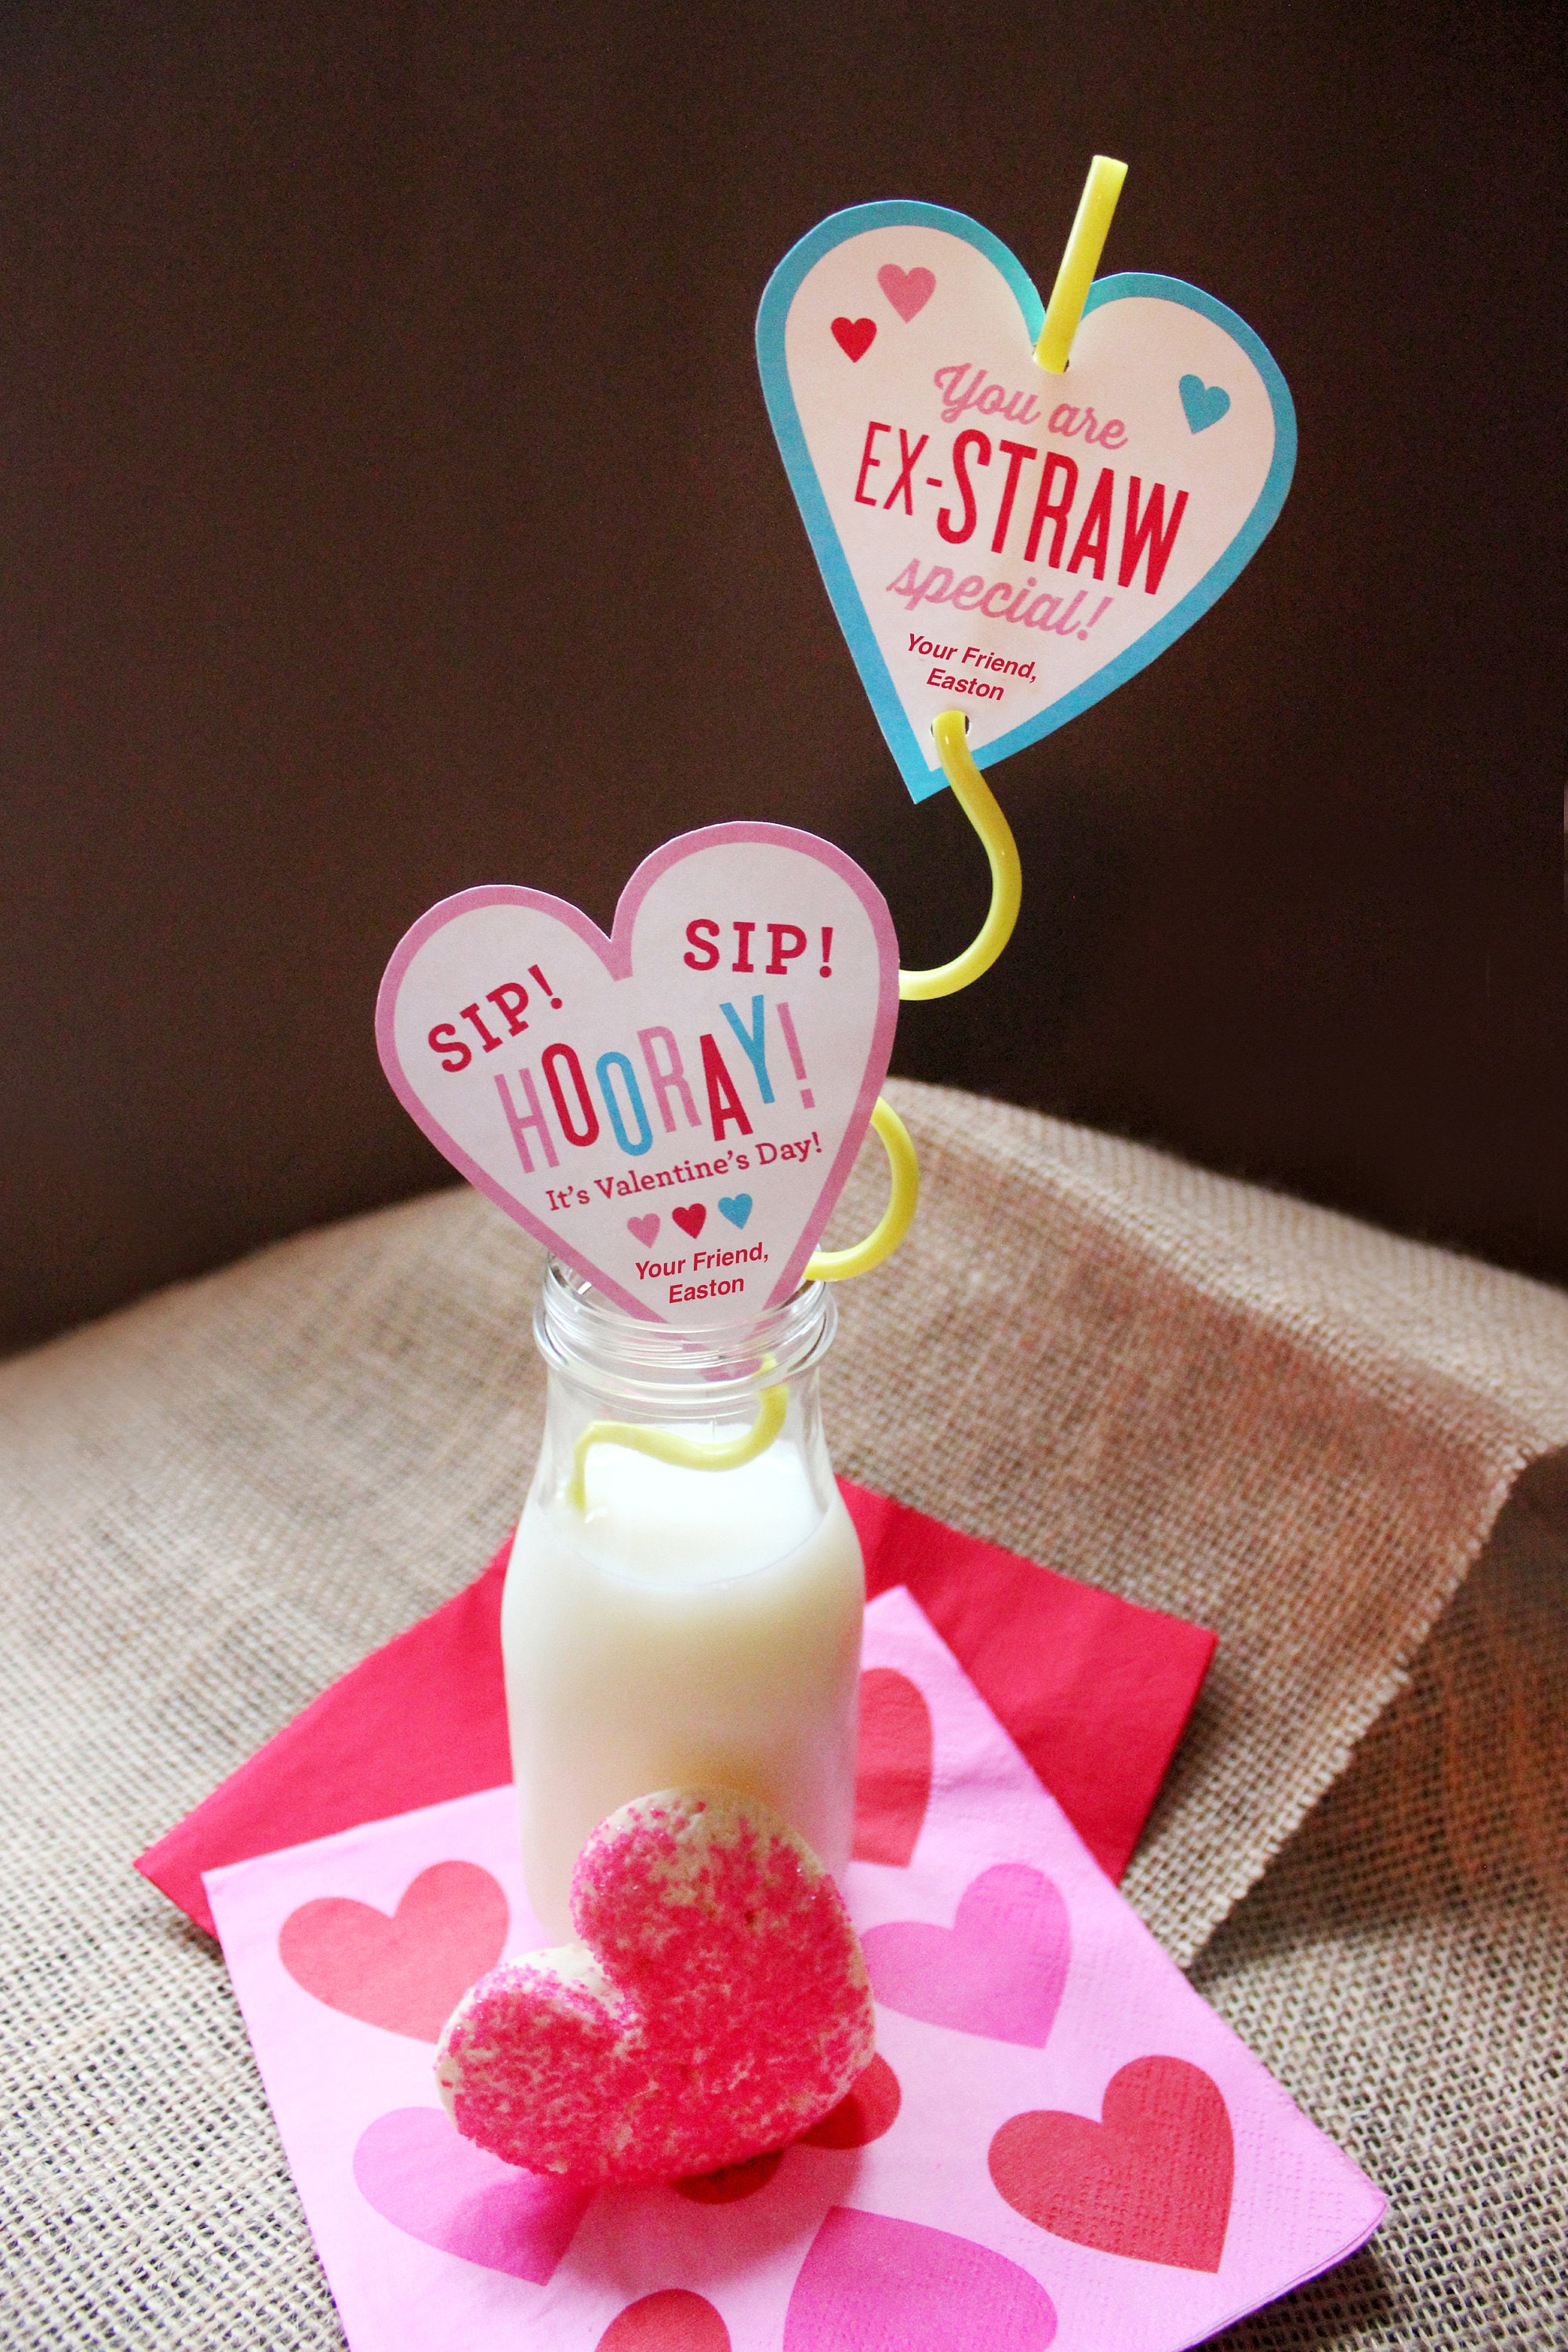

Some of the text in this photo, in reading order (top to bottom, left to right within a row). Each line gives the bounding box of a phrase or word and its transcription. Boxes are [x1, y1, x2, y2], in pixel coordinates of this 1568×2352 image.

[935, 363, 1128, 450] You are
[855, 421, 1189, 595] EX-STRAW
[886, 558, 1113, 641] special!
[908, 633, 1036, 683] Your Friend,
[926, 667, 1005, 701] Easton
[684, 918, 833, 978] SIP!
[427, 964, 562, 1073] SIP!
[494, 994, 815, 1173] HOORAY!
[546, 1132, 822, 1210] It's Valentine's Day!
[635, 1242, 769, 1280] Your Friend,
[668, 1275, 745, 1303] Easton
